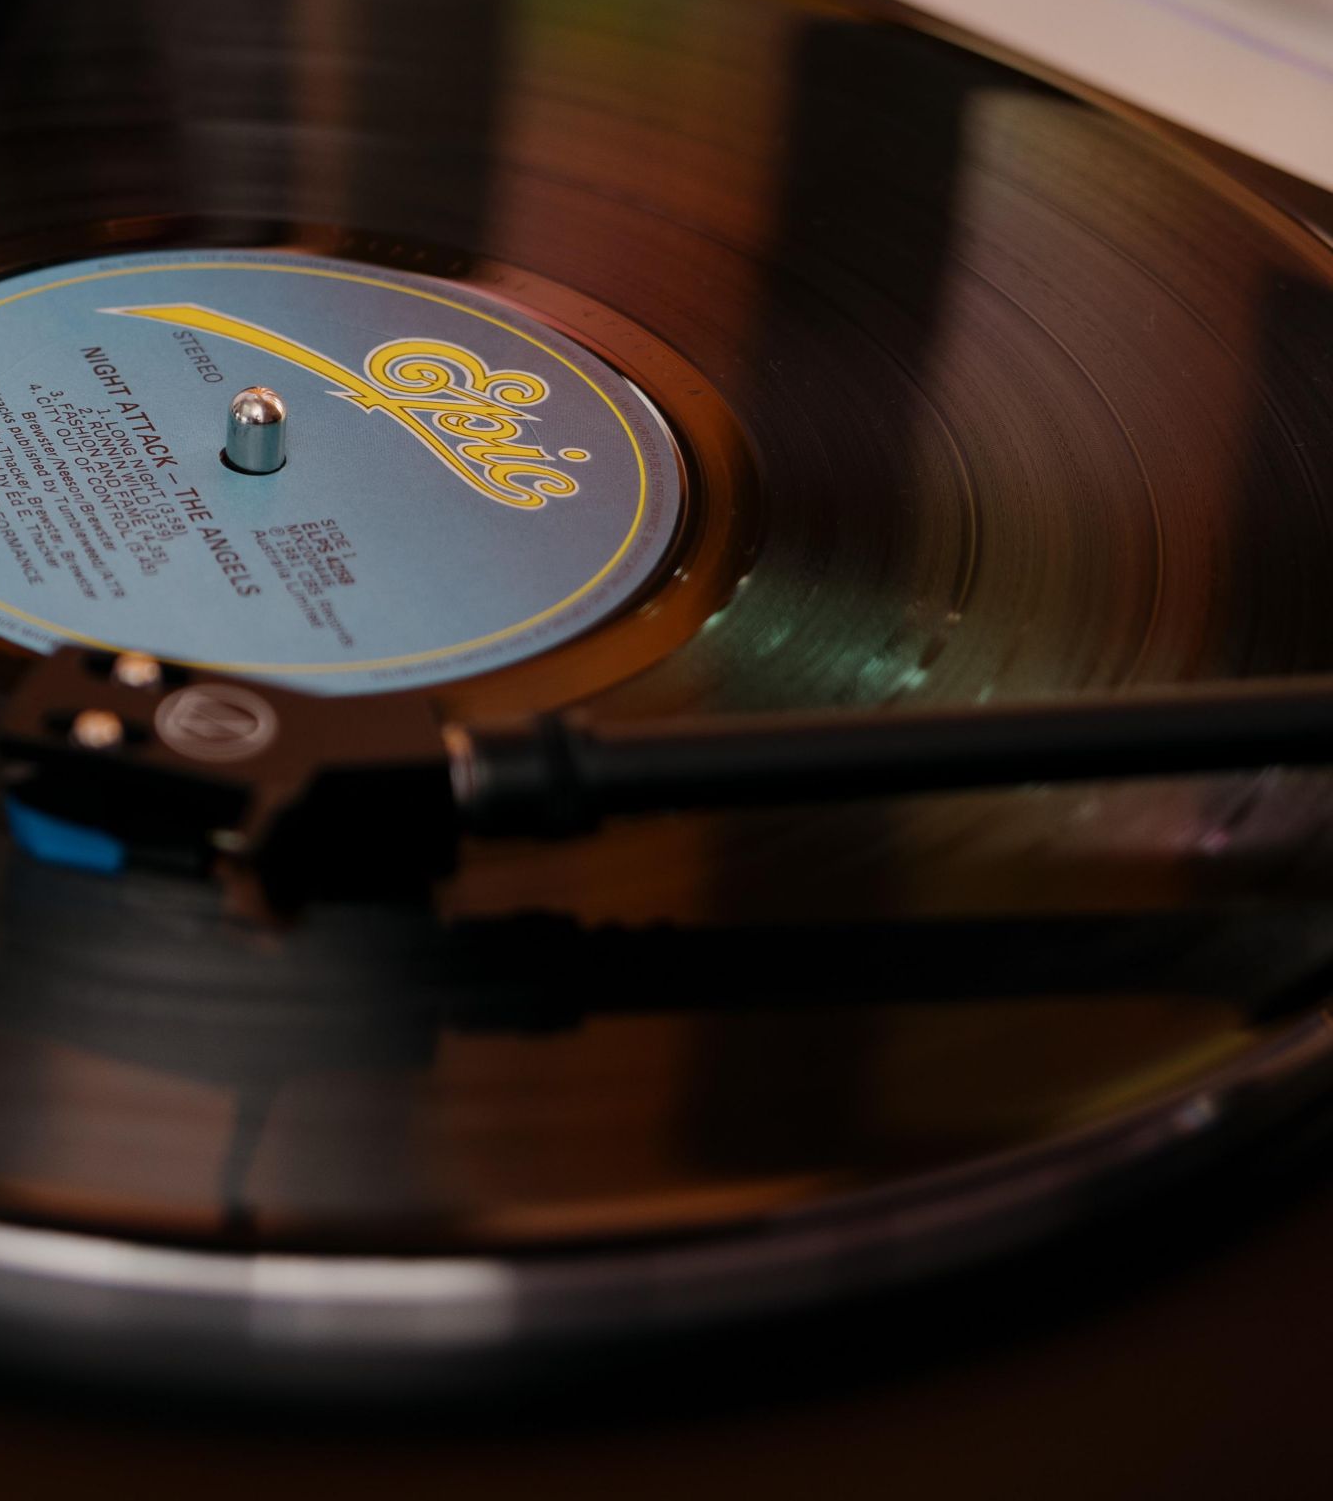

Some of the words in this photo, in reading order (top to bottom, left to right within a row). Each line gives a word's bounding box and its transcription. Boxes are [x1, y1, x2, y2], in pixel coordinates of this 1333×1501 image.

[172, 330, 224, 383] STEREO
[7, 427, 51, 476] published
[43, 480, 59, 492] by
[22, 412, 115, 550] Brewster/Neeson/Brewster
[29, 385, 42, 394] 4.
[37, 397, 65, 424] CITY
[57, 429, 83, 452] OUT
[75, 458, 96, 473] OF
[88, 478, 129, 538] CONTROL
[50, 391, 64, 401] 3.
[58, 404, 103, 457] FASHION
[94, 462, 121, 487] AND
[114, 491, 147, 526] FAME
[78, 408, 93, 418] 2.
[87, 422, 129, 469] RUNNIN
[121, 473, 150, 504] WILD
[141, 509, 173, 541] (3.59)
[81, 347, 131, 395] NIGHT
[115, 403, 178, 468] ATTACK
[175, 487, 213, 522] THE
[197, 528, 260, 597] ANGELS
[97, 409, 111, 419] 1.
[105, 422, 137, 455] LONG
[130, 460, 166, 498] NIGHT
[155, 503, 188, 535] (3.58)
[6, 491, 24, 506] Ed
[17, 509, 32, 521] E.
[27, 524, 59, 568] Thacker
[250, 530, 290, 579] Australia
[277, 541, 300, 567] 1981
[298, 574, 323, 595] CBS
[301, 523, 333, 552] ELPS
[321, 519, 351, 549] SIDE
